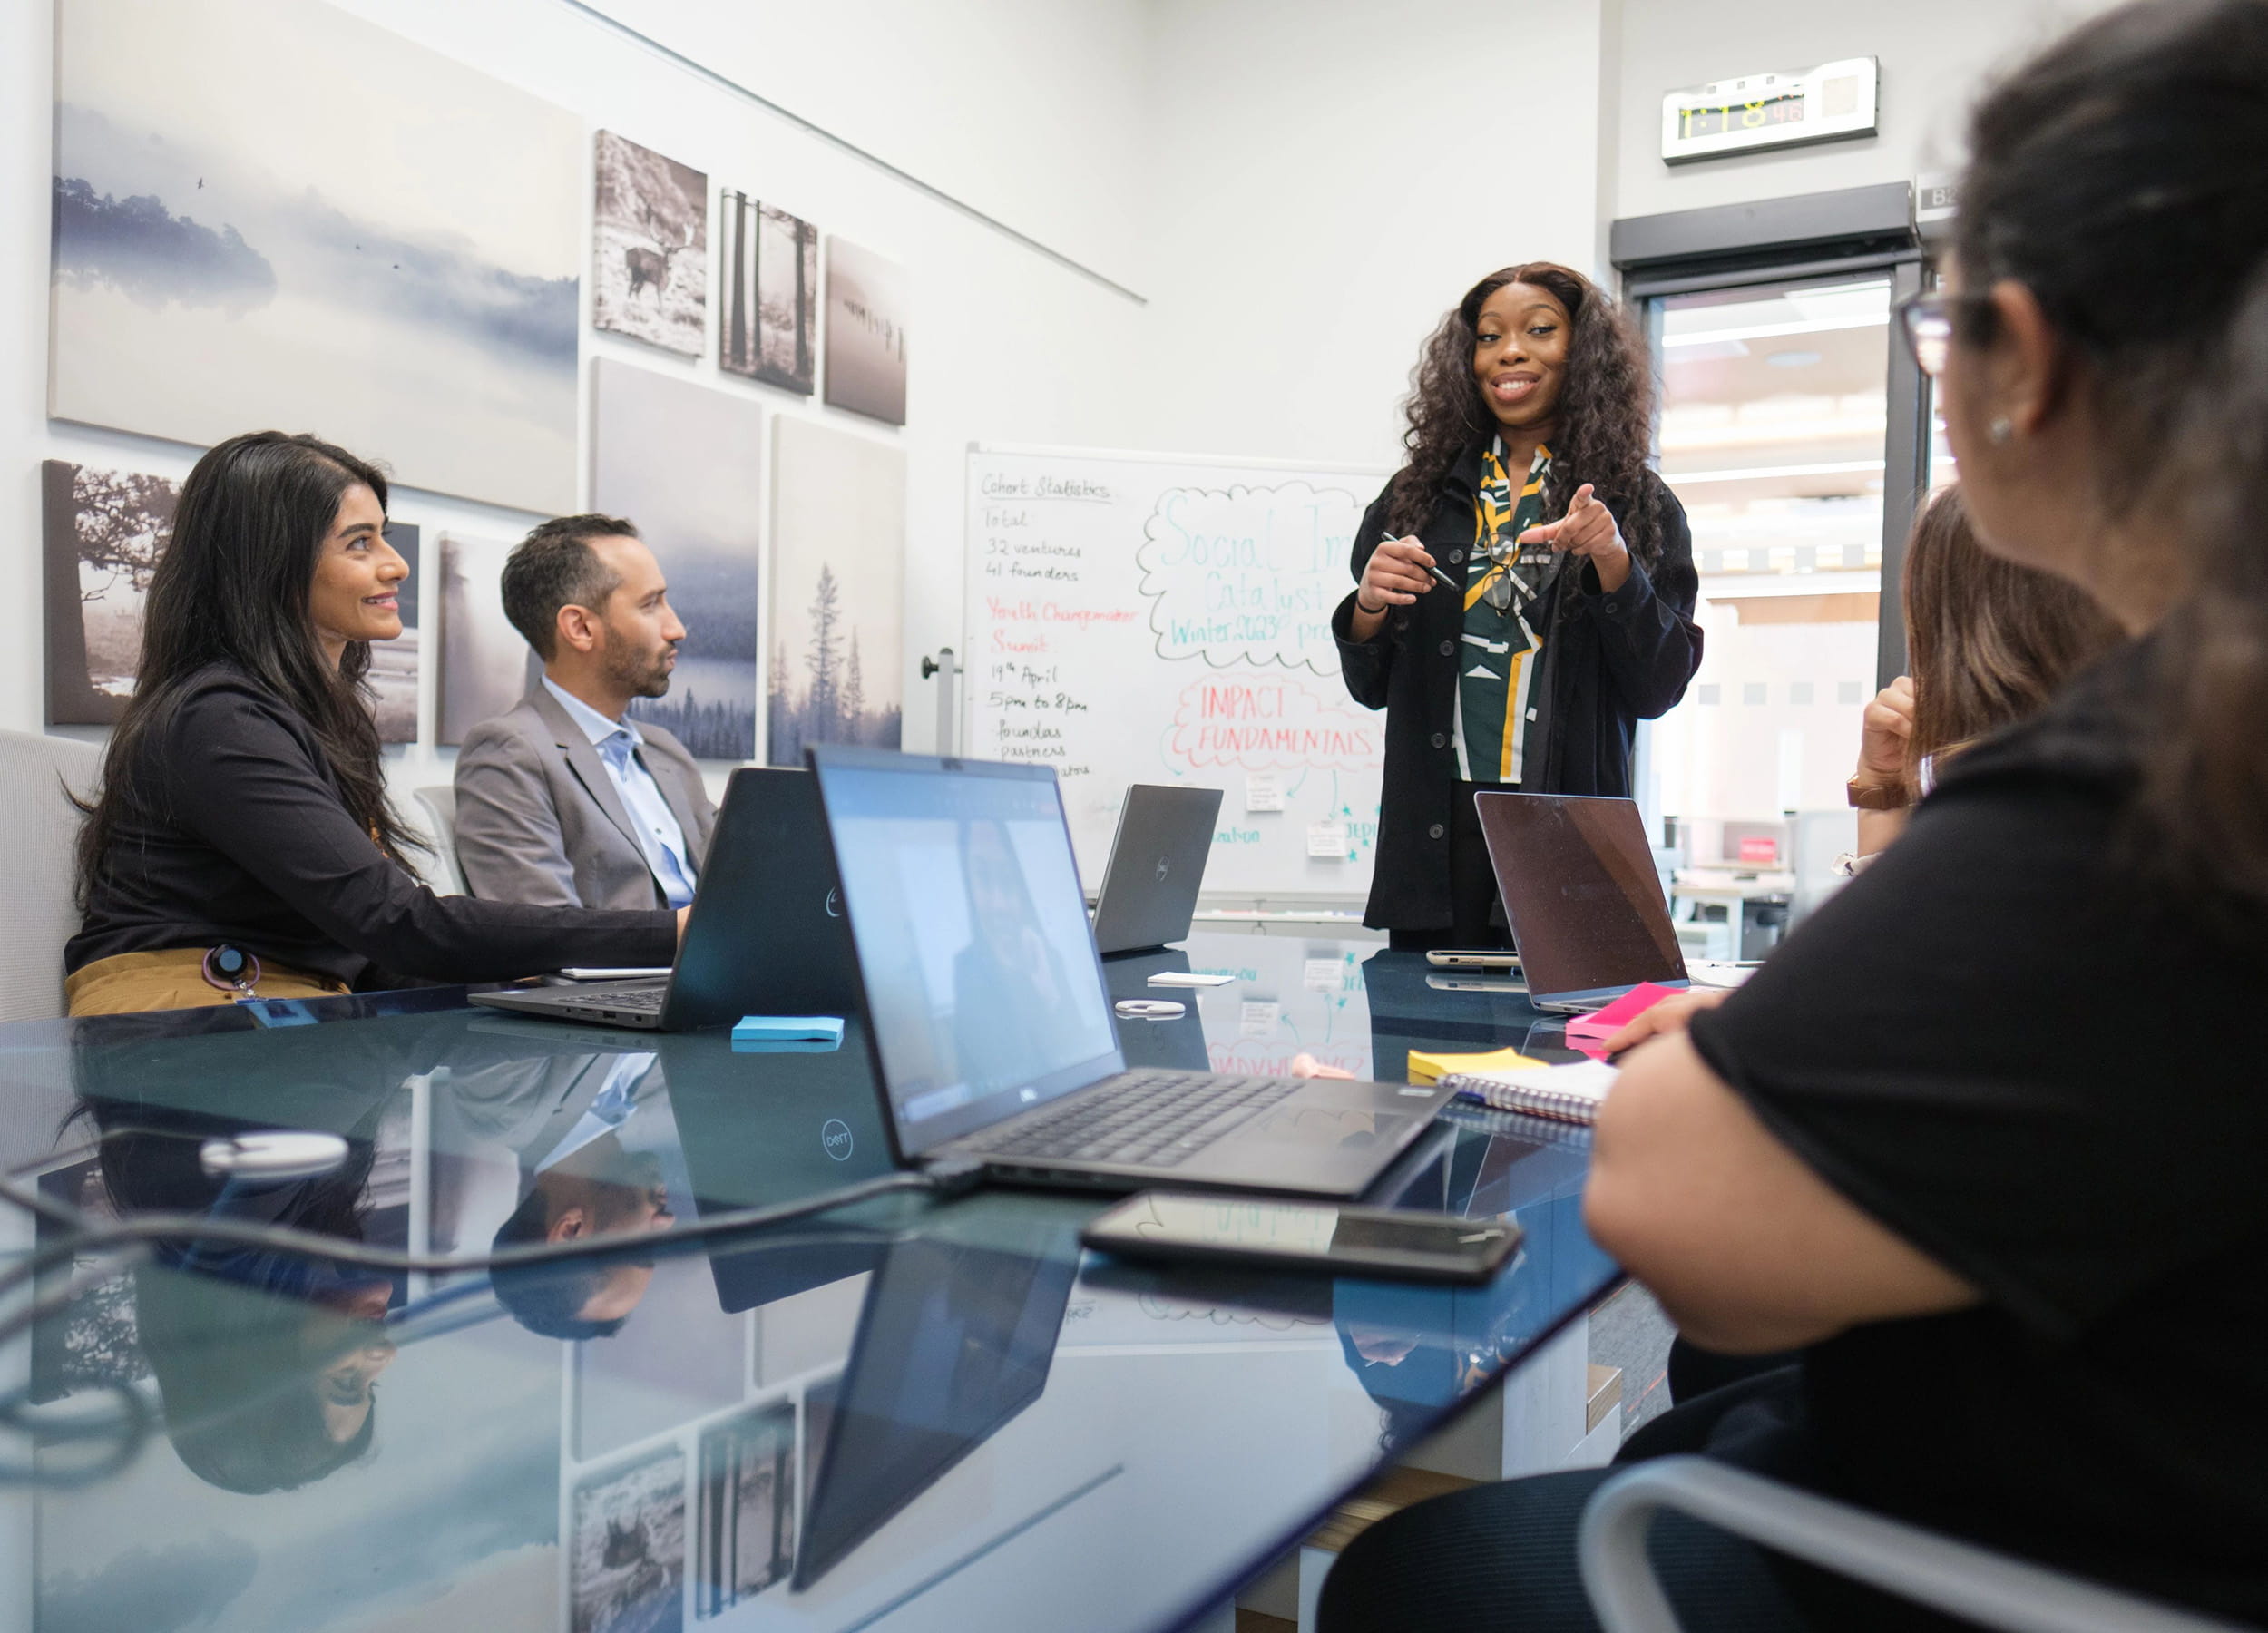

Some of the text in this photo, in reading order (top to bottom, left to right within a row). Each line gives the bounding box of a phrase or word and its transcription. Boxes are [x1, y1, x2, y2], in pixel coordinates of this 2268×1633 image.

[982, 473, 1111, 498] Cohort Statistics
[1160, 494, 1282, 572] Social
[985, 538, 1081, 558] 32 ventures
[986, 561, 1079, 582] 41 founders
[1205, 571, 1327, 613] Catalyst
[986, 595, 1037, 621] Youth
[1022, 665, 1058, 689] April
[987, 691, 1088, 715] 5pm to 8pm
[1200, 685, 1286, 720] IMPACT
[1000, 745, 1066, 762] partners
[1198, 727, 1374, 755] FUNDAMENTALS
